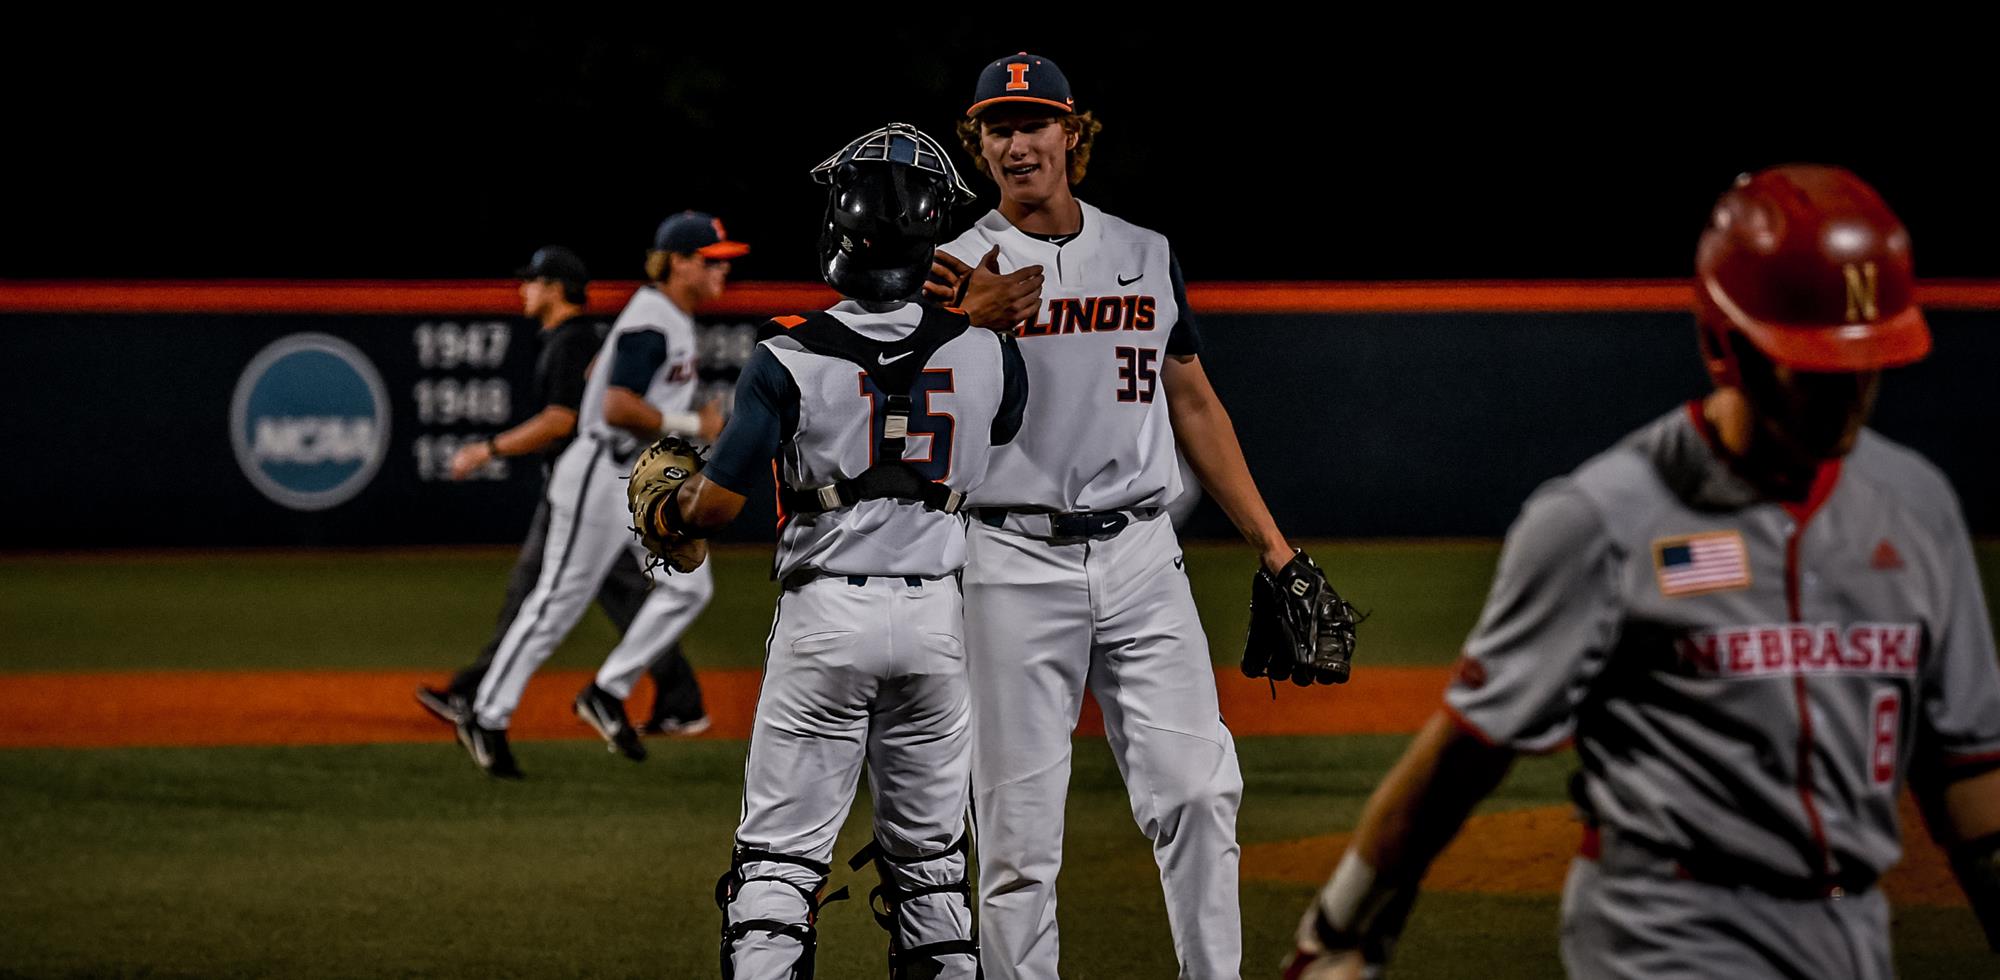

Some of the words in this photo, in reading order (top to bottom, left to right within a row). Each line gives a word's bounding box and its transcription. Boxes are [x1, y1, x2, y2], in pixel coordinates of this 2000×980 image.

[1006, 63, 1030, 91] I
[1014, 294, 1156, 338] LINOIS
[1843, 261, 1876, 321] N
[413, 322, 511, 369] 1947
[1115, 345, 1158, 404] 35
[256, 416, 372, 462] NCAA
[1674, 622, 1919, 678] NEBRASK
[1869, 688, 1900, 790] 8
